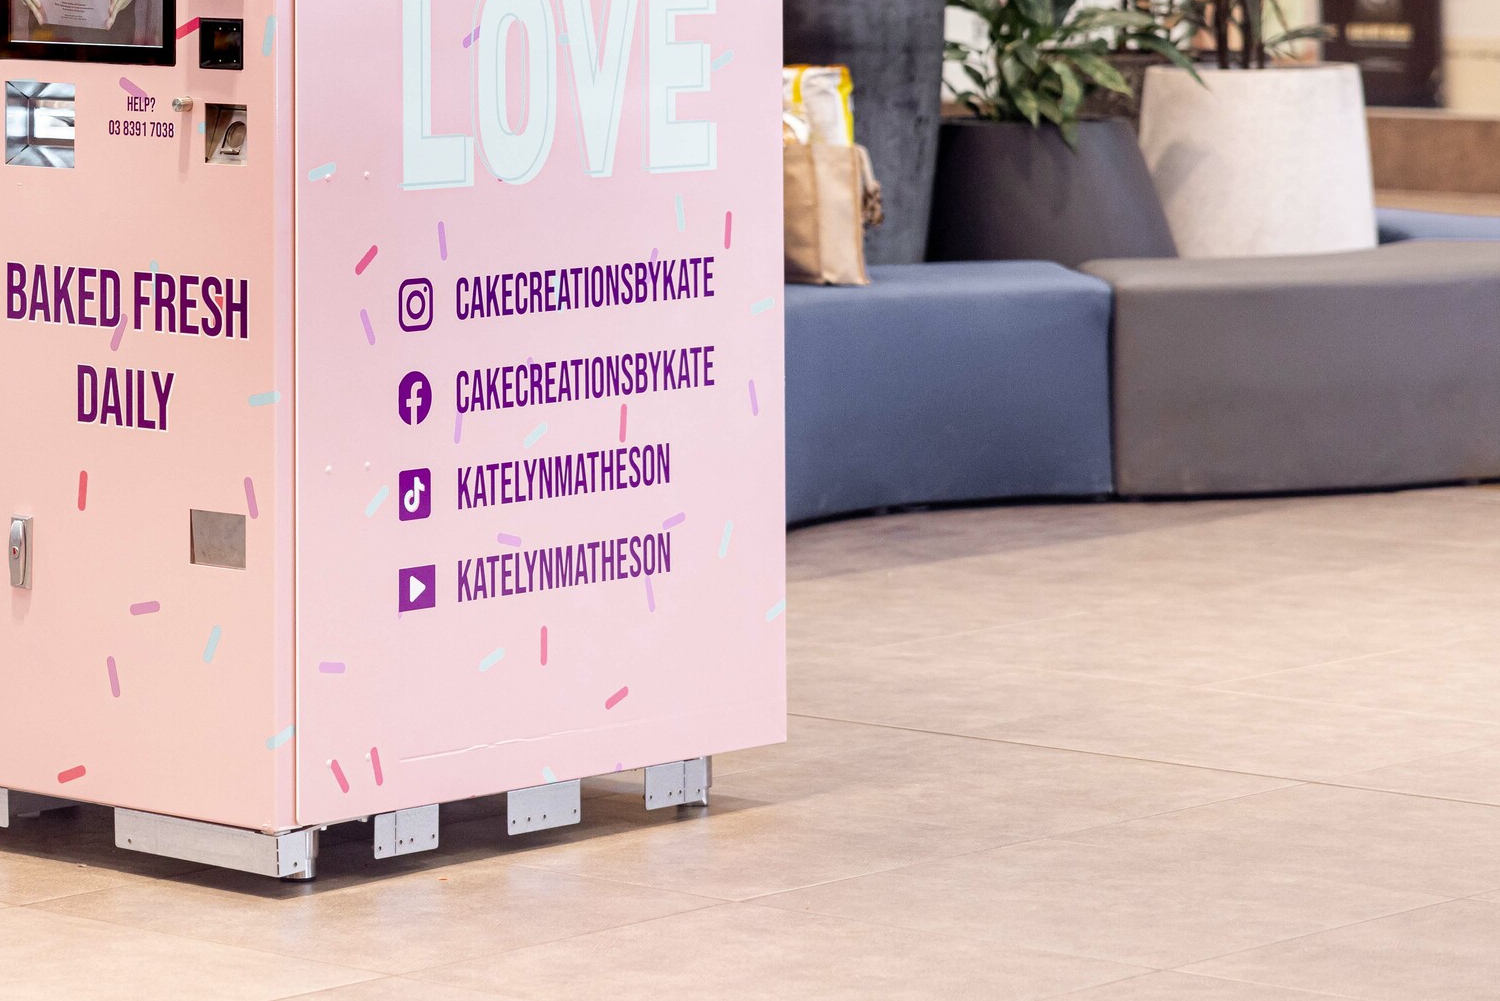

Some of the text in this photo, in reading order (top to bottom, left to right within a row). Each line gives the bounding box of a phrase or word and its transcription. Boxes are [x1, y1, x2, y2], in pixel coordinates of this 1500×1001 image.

[108, 119, 175, 138] 03 8391 7038
[127, 96, 156, 112] HELP?
[6, 262, 248, 339] BAKED FRESH
[456, 256, 715, 321] CAKECREATIONSBYKATE
[77, 364, 175, 431] DAILY
[456, 345, 715, 414] CAKECREATIONSBYKATE
[457, 442, 670, 510] KATELYNMATHESON
[457, 531, 671, 603] KATELYNMATHESON
